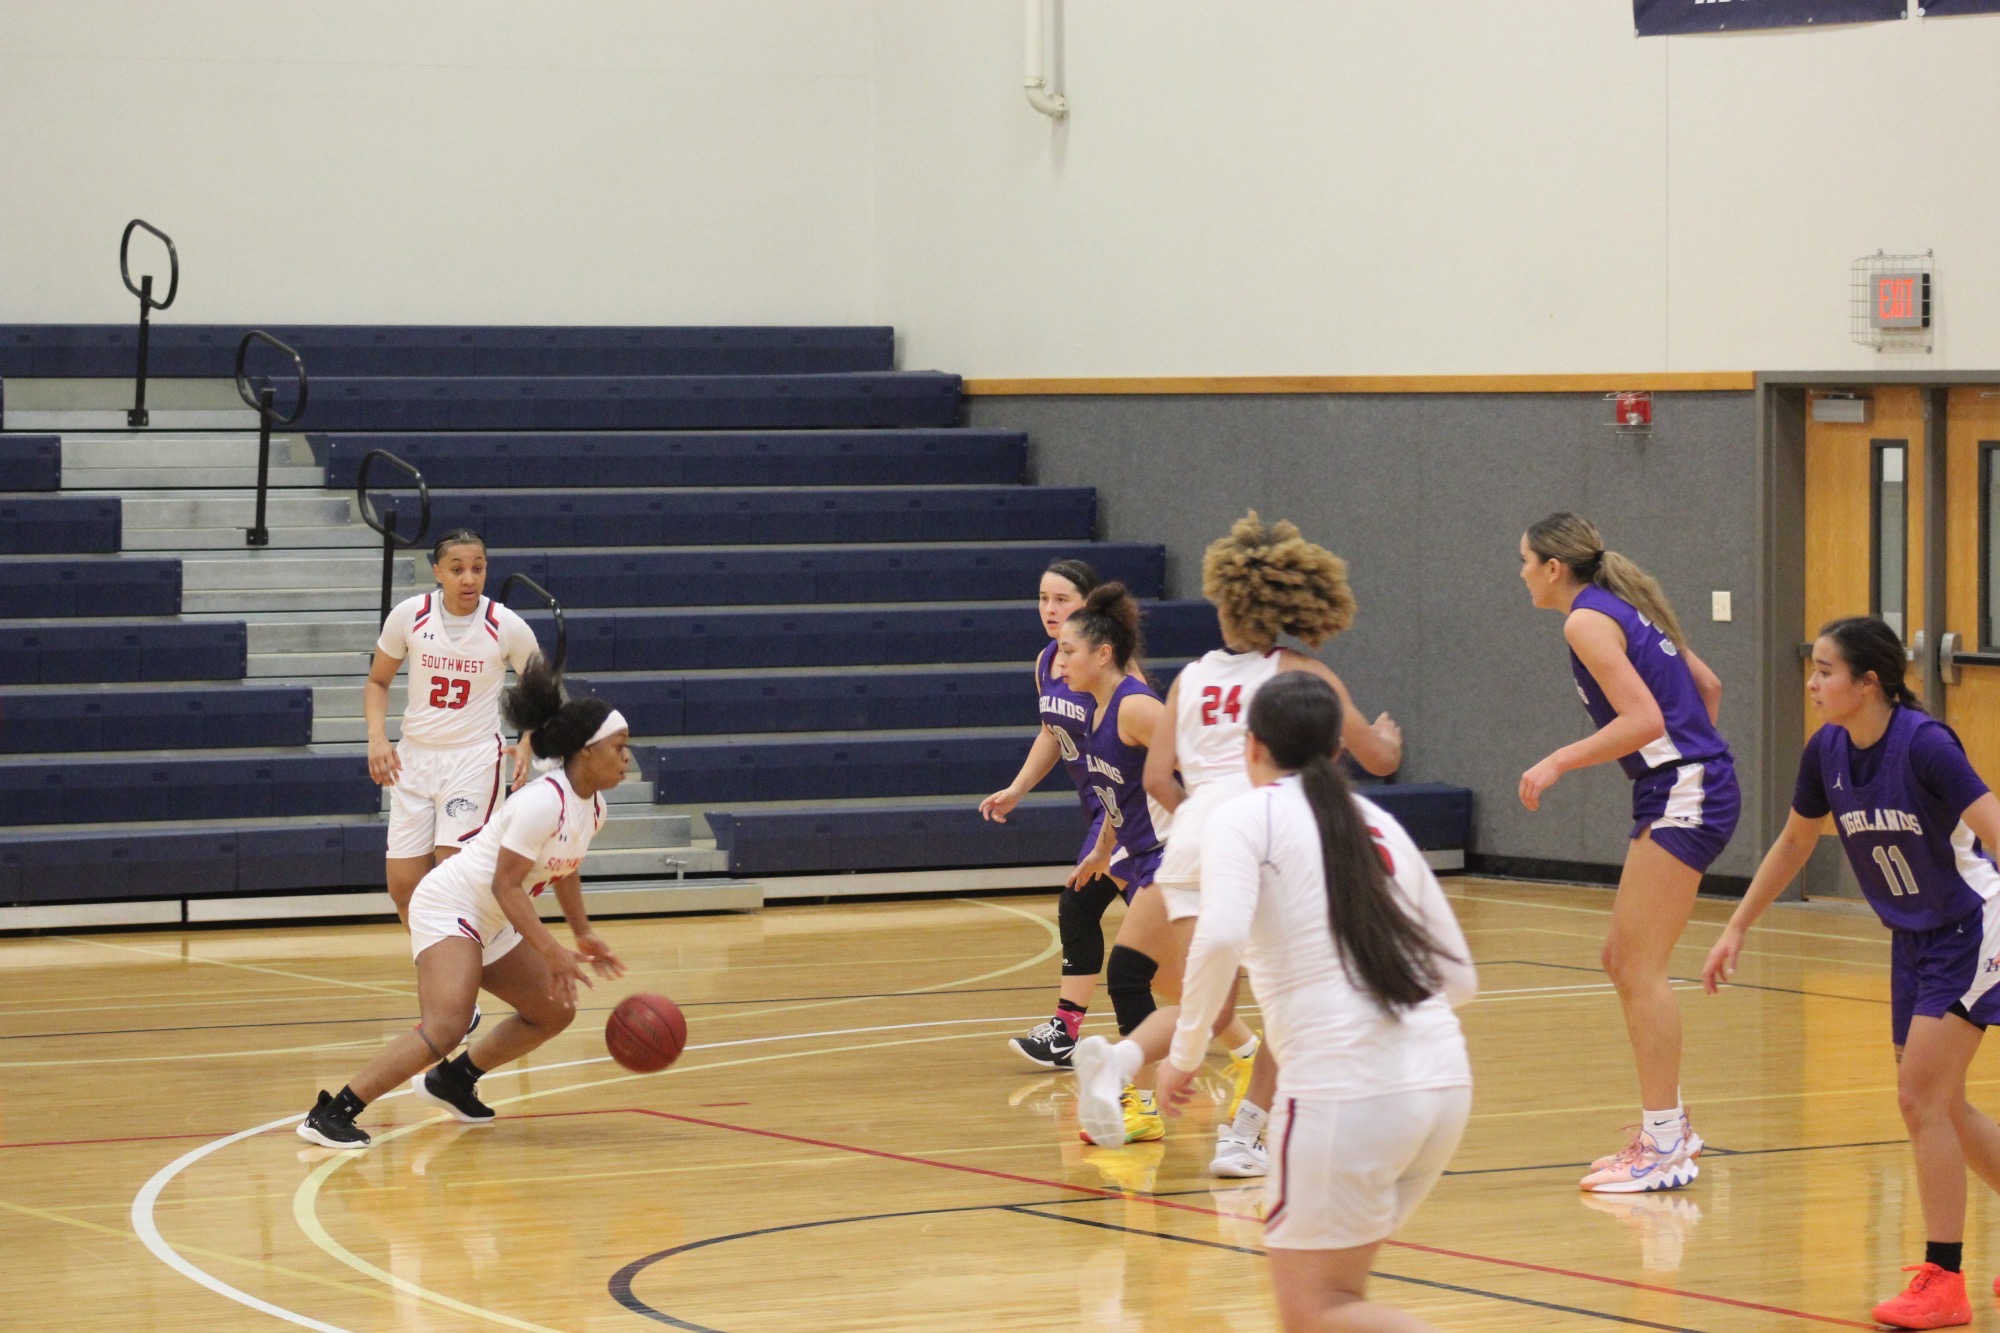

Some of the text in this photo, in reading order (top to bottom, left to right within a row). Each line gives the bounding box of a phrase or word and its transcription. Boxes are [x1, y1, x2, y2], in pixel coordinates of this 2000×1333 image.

[1878, 278, 1914, 319] EXIT
[422, 654, 484, 673] SOUTHWEST
[430, 675, 471, 709] 23
[1202, 685, 1242, 726] 24
[1086, 754, 1124, 784] LANDS
[1872, 845, 1919, 896] 11
